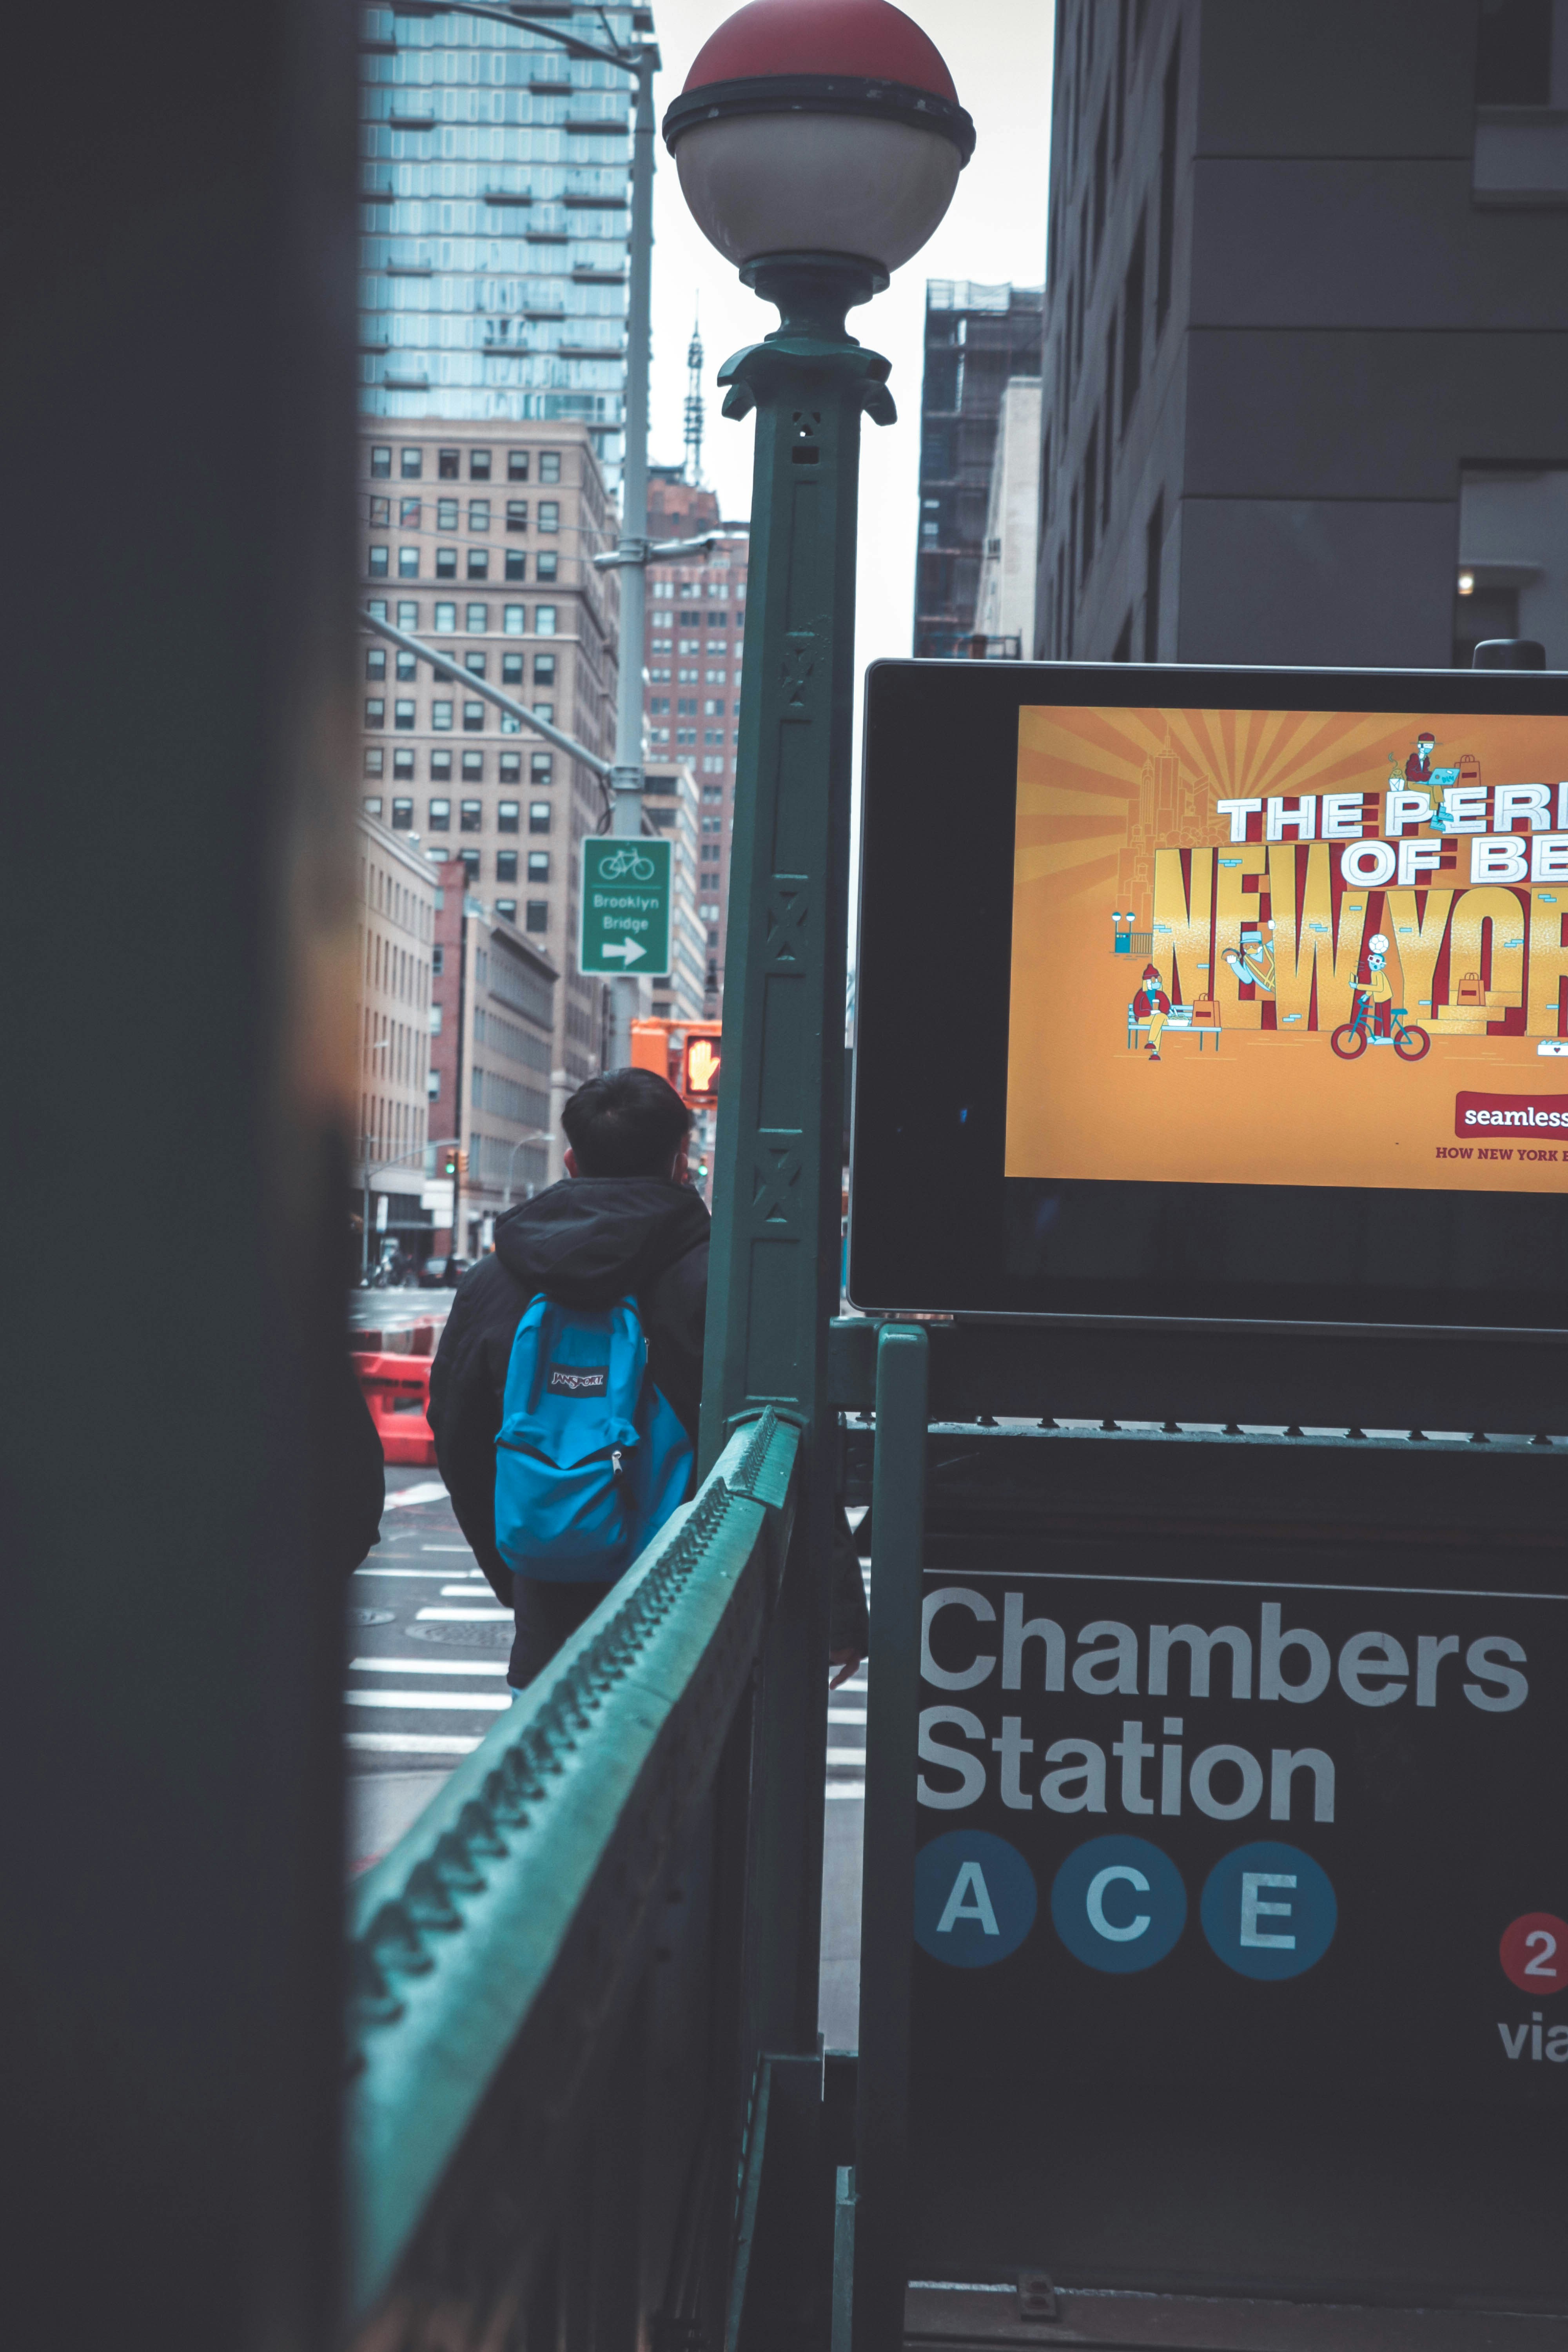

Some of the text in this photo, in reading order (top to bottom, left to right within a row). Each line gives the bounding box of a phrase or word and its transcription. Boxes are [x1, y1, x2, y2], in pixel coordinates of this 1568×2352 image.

[1217, 783, 1568, 842] THE PER
[1341, 838, 1441, 887] OF
[593, 893, 659, 912] Brooklyn
[603, 915, 649, 935] Bridge
[1152, 843, 1369, 1032] NEW
[1465, 1107, 1568, 1127] seamless
[1436, 1147, 1474, 1159] HOW
[1477, 1148, 1513, 1160] NEW
[1517, 1149, 1558, 1161] YORK
[552, 1372, 603, 1389] JANSPORT
[920, 1586, 1529, 1712] Chambers
[916, 1705, 1335, 1823] Station
[936, 1861, 1297, 1949] A C E
[1524, 1930, 1557, 1977] 2
[1497, 2011, 1568, 2063] via
